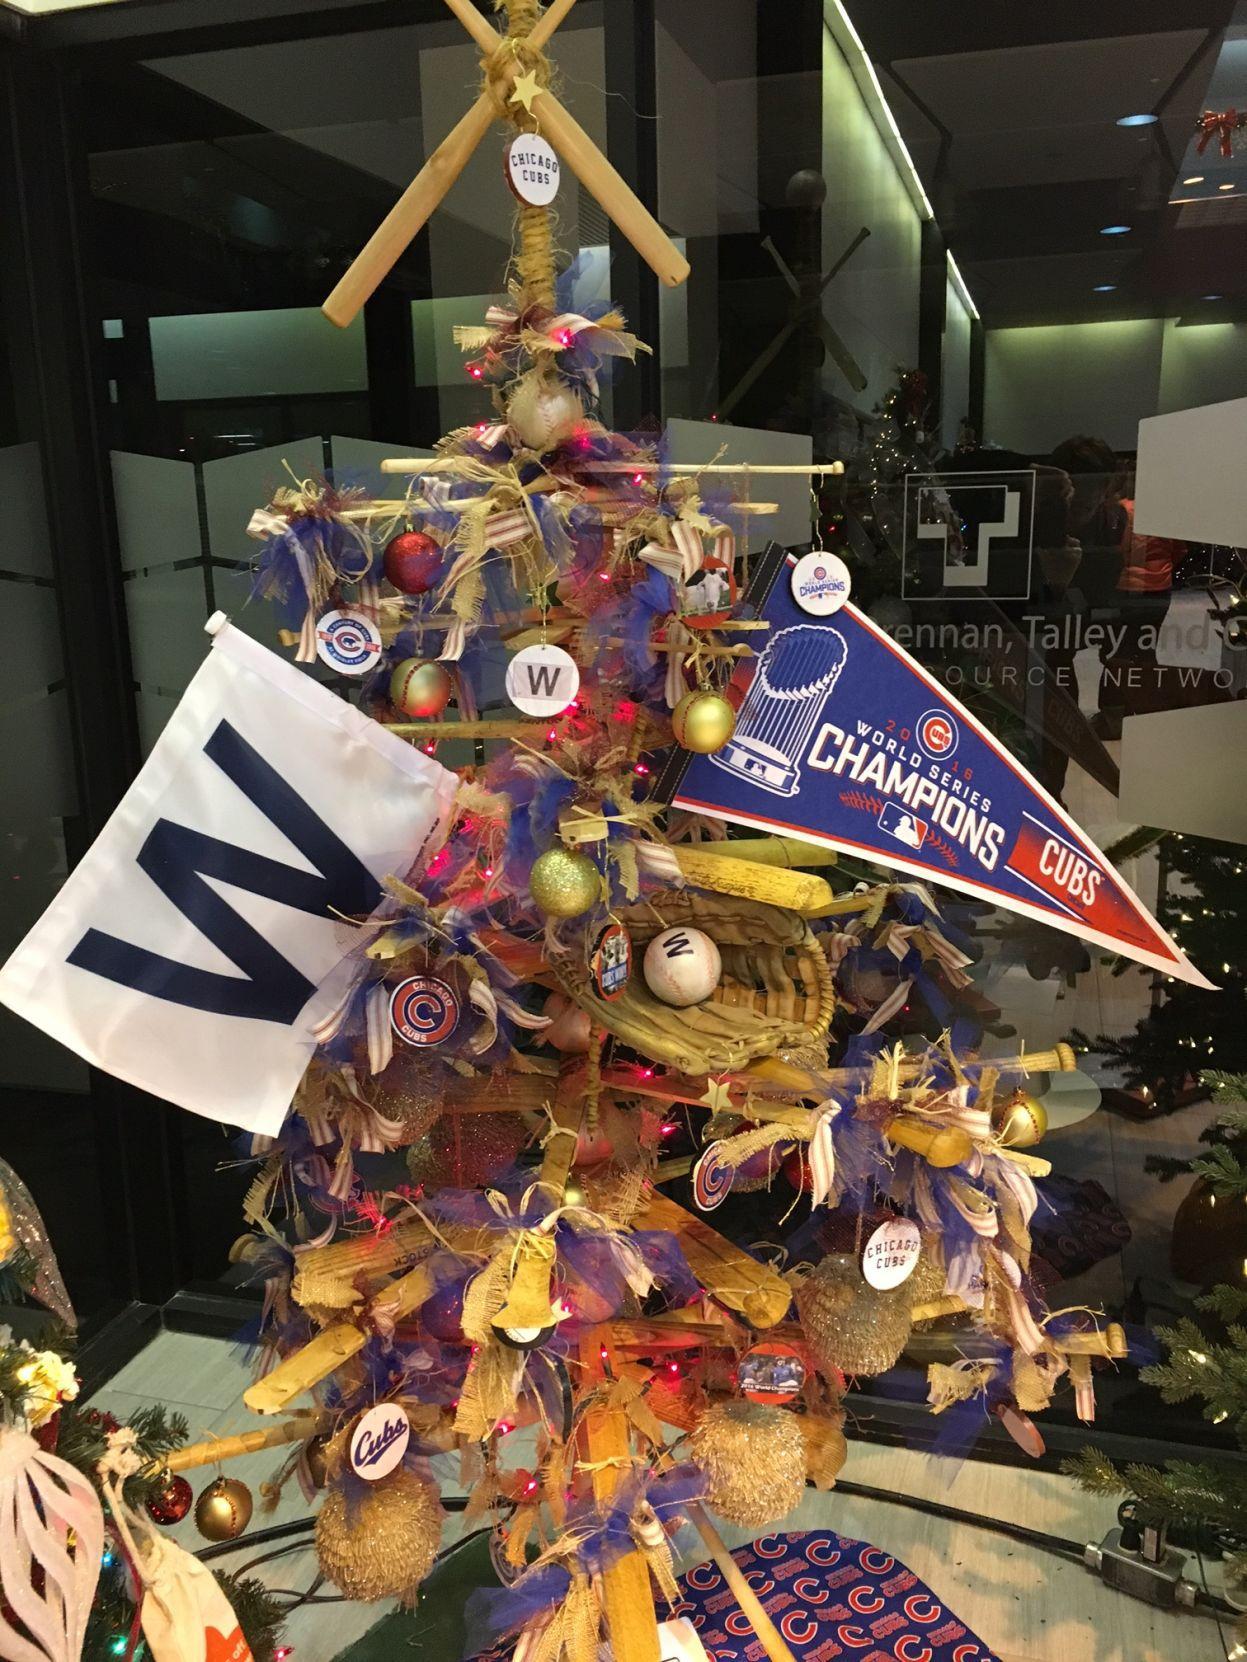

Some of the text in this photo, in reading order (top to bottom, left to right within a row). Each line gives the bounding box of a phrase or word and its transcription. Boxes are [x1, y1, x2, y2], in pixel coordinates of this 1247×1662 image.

[511, 153, 558, 173] CHICAGO
[522, 169, 550, 185] CUBS
[800, 581, 845, 597] CHAMPIONS
[882, 623, 1013, 654] ennan,
[1021, 614, 1127, 661] Talley
[1138, 611, 1210, 650] and
[527, 665, 561, 697] W
[925, 665, 1070, 688] OURCE
[857, 720, 992, 813] WORLD SERIES
[807, 722, 1006, 872] CHAMPIONS
[65, 717, 389, 1026] W
[1039, 839, 1101, 906] CUBS
[662, 931, 694, 958] W
[412, 981, 454, 1007] CHICAGO
[408, 994, 441, 1029] C
[401, 1025, 427, 1042] CUBS
[867, 1239, 918, 1258] CHICAGO
[876, 1255, 906, 1269] CUBS
[354, 1417, 408, 1468] Cubs
[805, 1539, 841, 1567] C
[859, 1546, 894, 1575] C
[686, 1561, 721, 1591] C
[793, 1577, 829, 1604] C
[848, 1585, 885, 1614] C
[904, 1594, 941, 1624] C
[781, 1610, 818, 1645] C
